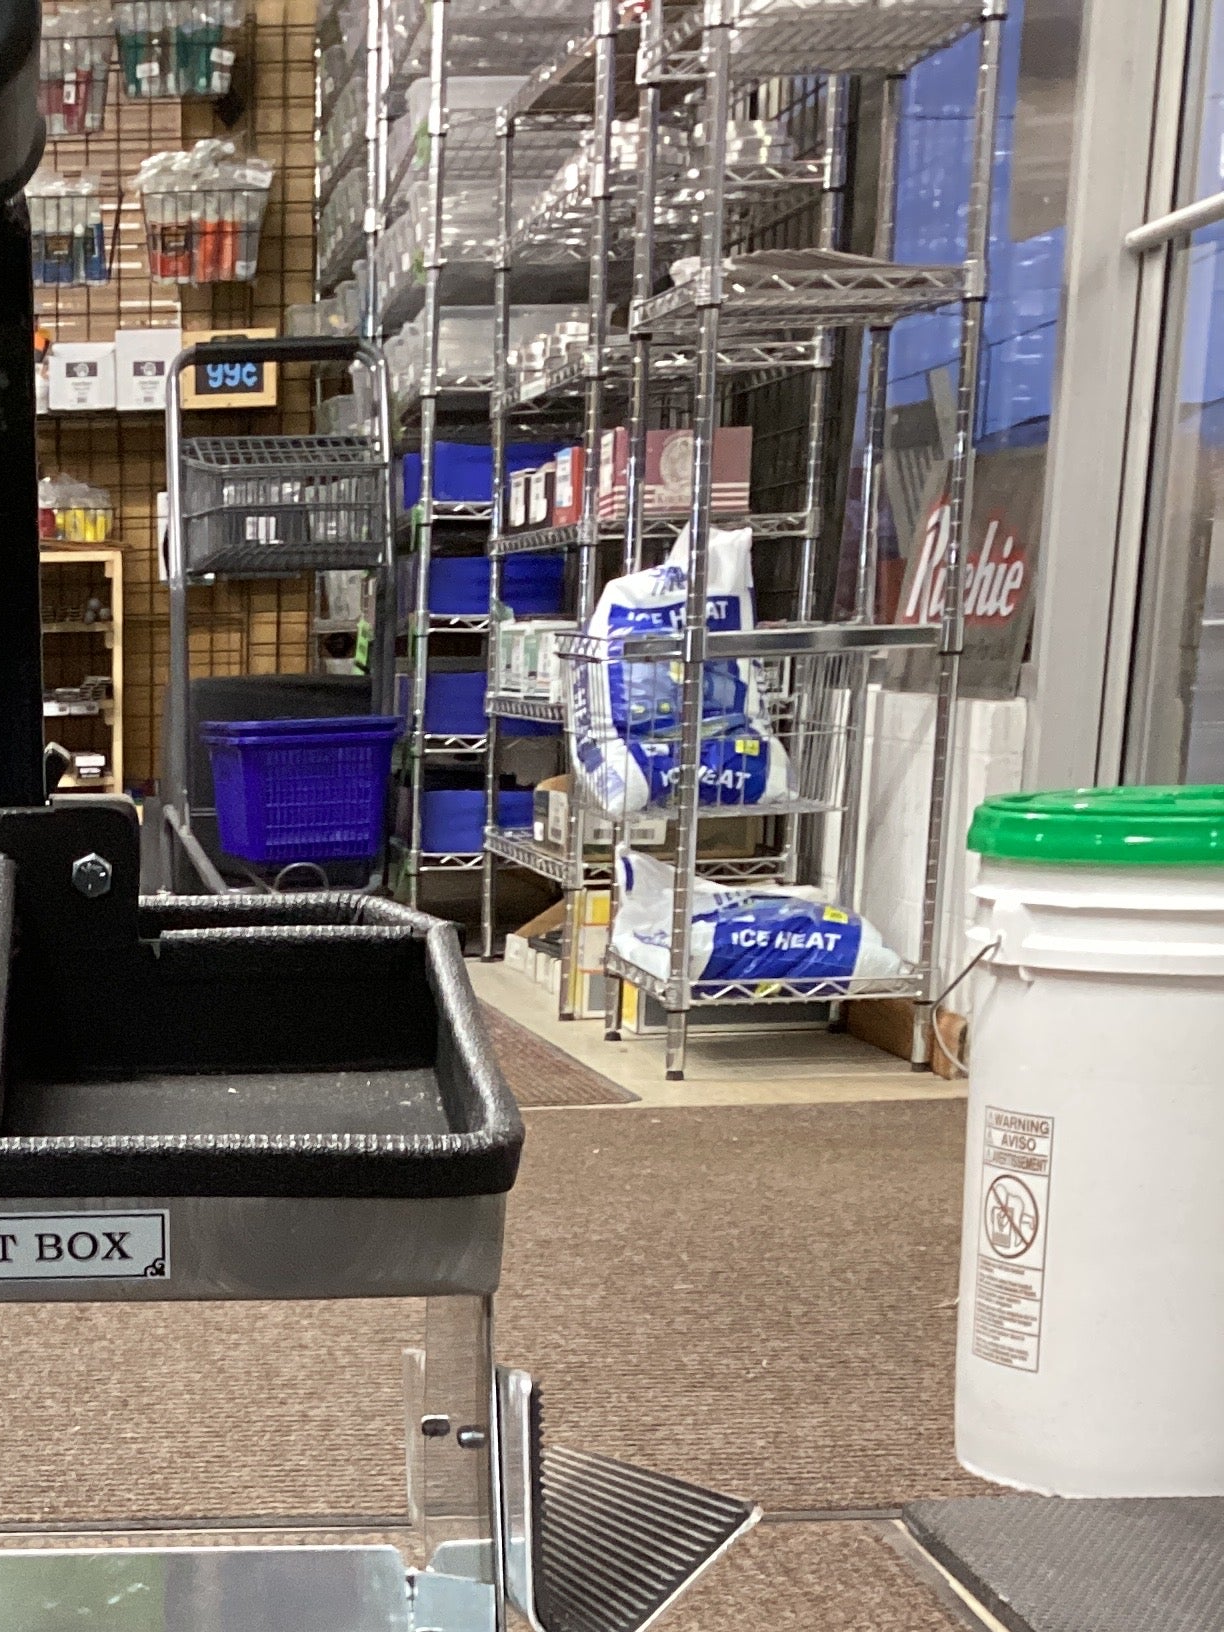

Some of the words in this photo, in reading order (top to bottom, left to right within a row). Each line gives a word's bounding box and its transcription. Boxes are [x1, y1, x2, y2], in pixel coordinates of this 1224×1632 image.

[905, 505, 1024, 625] Richie
[669, 601, 729, 628] HAT
[731, 928, 771, 948] ICE
[775, 931, 842, 952] HEAT
[994, 1112, 1050, 1134] WARNING
[1001, 1132, 1037, 1152] AVISO
[34, 1230, 134, 1263] BOX
